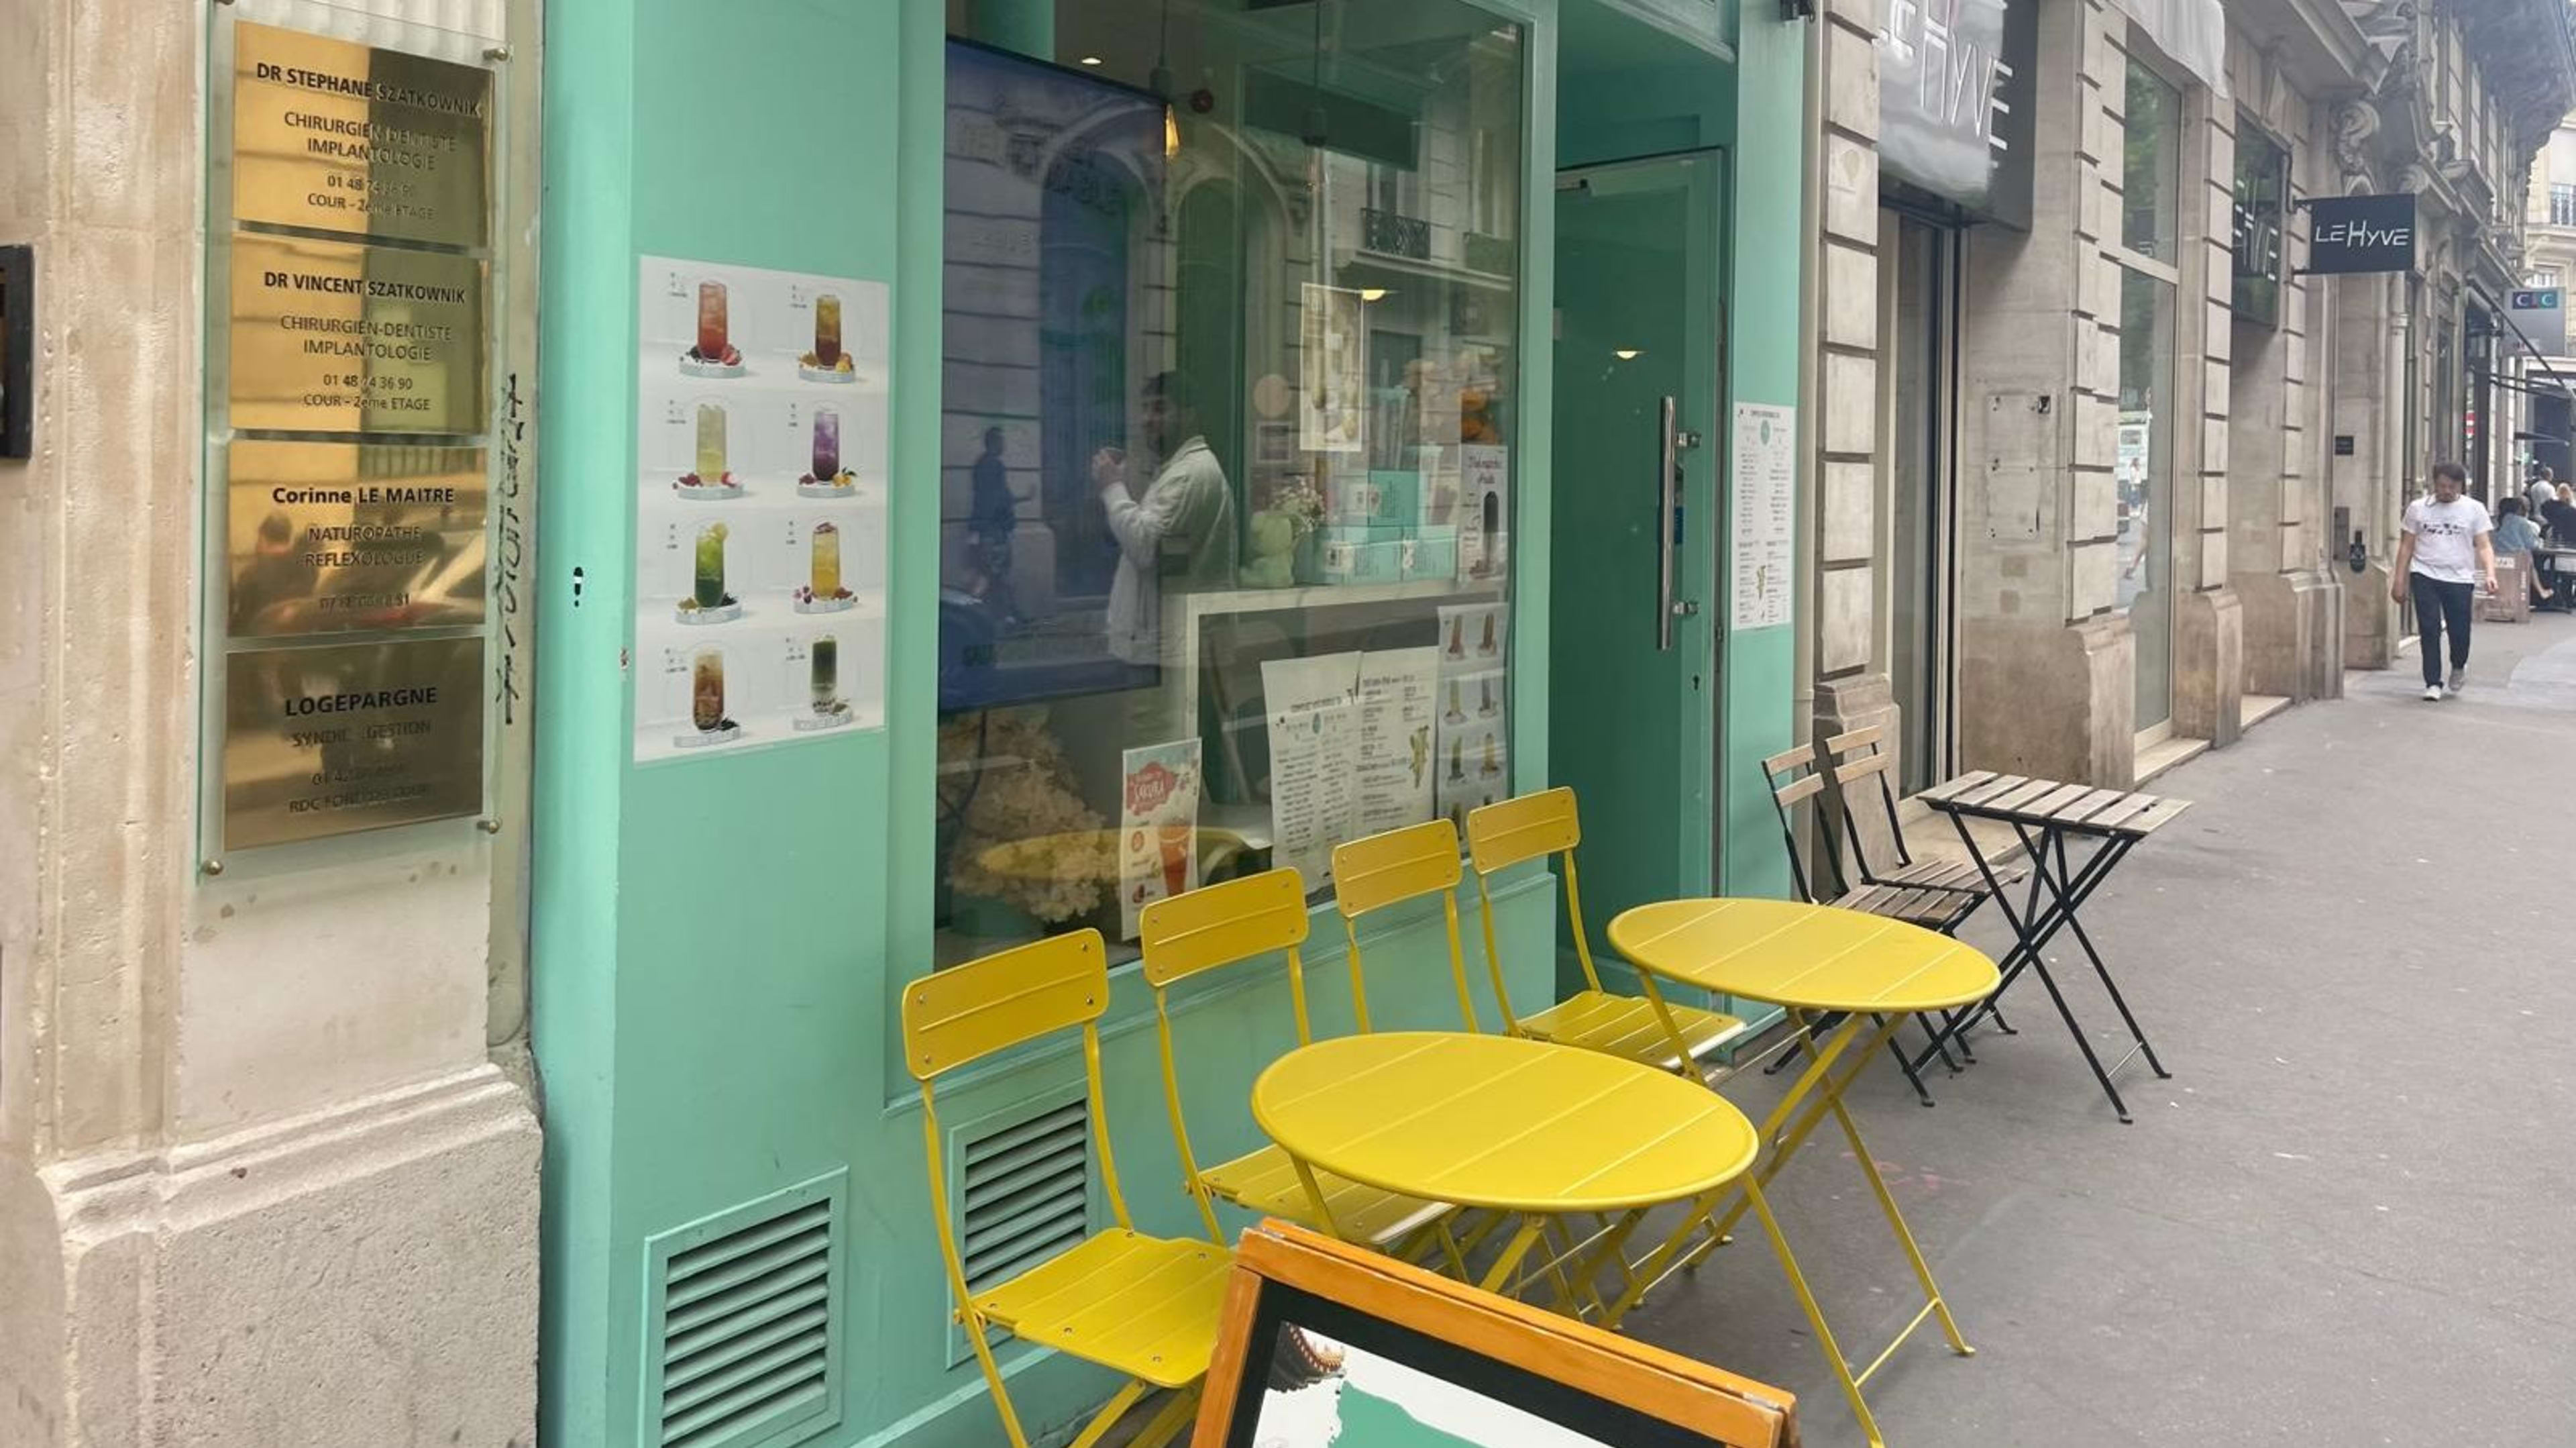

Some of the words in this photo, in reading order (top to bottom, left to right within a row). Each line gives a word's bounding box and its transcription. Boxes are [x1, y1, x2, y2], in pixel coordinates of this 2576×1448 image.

[258, 62, 281, 81] DR
[287, 68, 372, 98] STEPHANE
[377, 84, 480, 115] SZATKOWNIK
[308, 138, 436, 170] IMPLANTOLOGIE
[308, 193, 346, 209] COUR
[264, 271, 287, 289] DR
[293, 274, 362, 295] VINCENT
[368, 280, 465, 303] SZATKOWNIK
[280, 315, 452, 340] CHIRURGIEN-DENTISTE
[304, 340, 431, 361] IMPLANTOLOGIE
[323, 374, 337, 386] 01
[343, 375, 358, 387] 48
[380, 376, 394, 390] 36
[398, 377, 413, 391] 90
[304, 394, 341, 408] COUR
[391, 397, 431, 411] ETAGE
[273, 487, 352, 505] Corinne
[359, 488, 379, 504] LE
[386, 487, 455, 504] MAITRE
[309, 526, 421, 542] NATUROPATHE
[285, 687, 437, 717] LOGEPARGNE
[289, 798, 320, 813] RDC
